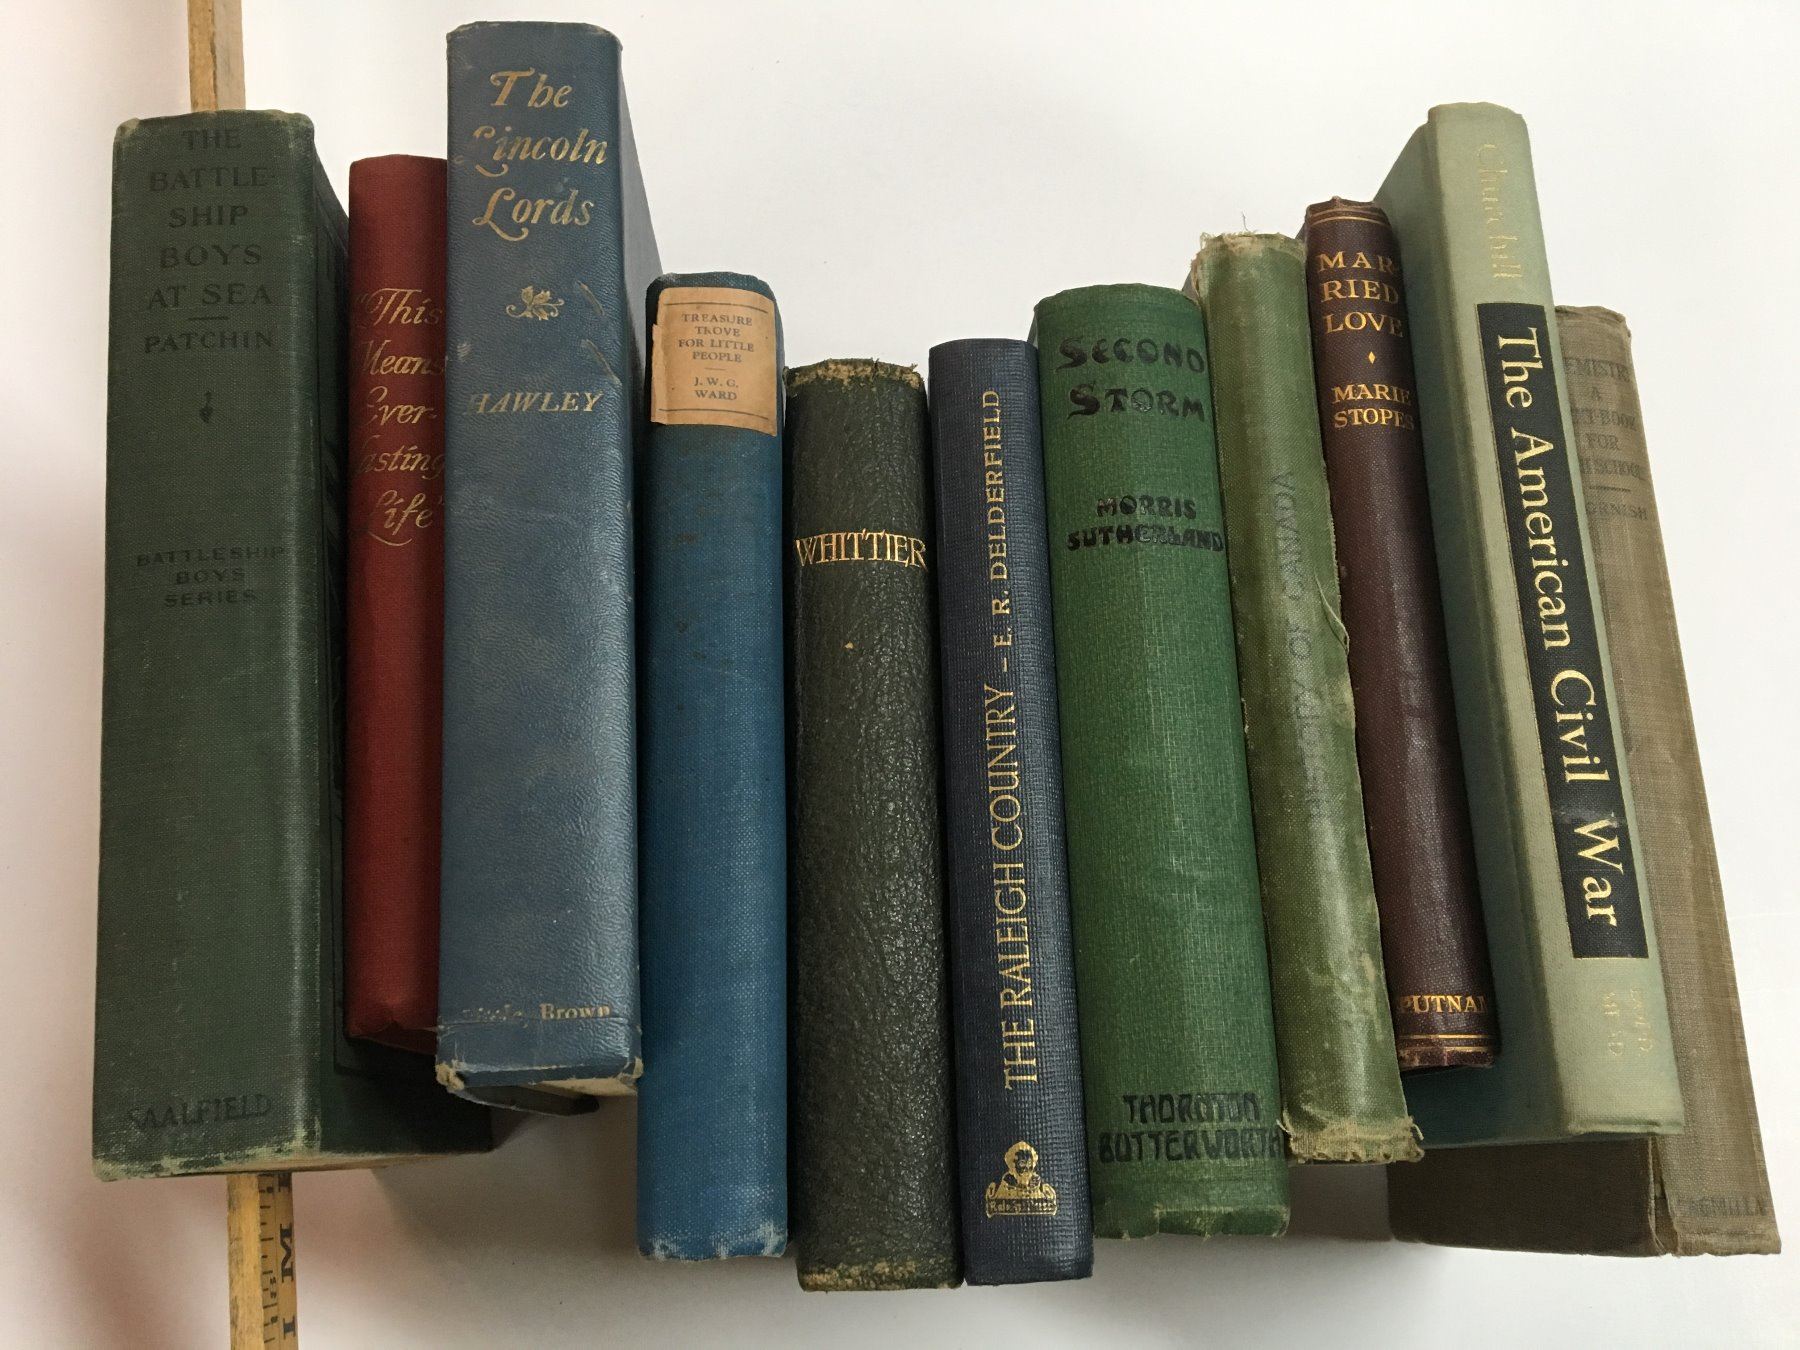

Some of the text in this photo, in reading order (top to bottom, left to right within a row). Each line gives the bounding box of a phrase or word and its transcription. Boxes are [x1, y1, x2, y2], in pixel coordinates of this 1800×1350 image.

[490, 67, 573, 108] The
[182, 129, 242, 150] THE
[472, 125, 608, 178] Lincoln
[168, 205, 249, 229] SHIP
[472, 187, 594, 242] Lords
[160, 244, 263, 269] BOYS
[147, 283, 273, 309] AT SEA
[1321, 279, 1400, 305] RIED
[681, 313, 753, 326] TREASURE
[695, 326, 741, 337] TROVE
[1323, 311, 1404, 338] LOVE
[144, 331, 273, 354] PATCHIN
[678, 338, 755, 352] FOR LITTLE
[1055, 336, 1206, 374] SECOND
[692, 351, 743, 363] PEOPLE
[463, 391, 605, 416] HAWLEY
[694, 390, 738, 401] WARD
[1067, 380, 1206, 422] STORM
[982, 390, 1009, 581] DELDERFIELD
[1097, 495, 1198, 520] MORRIS
[794, 528, 929, 572] WHITTIER
[1067, 524, 1225, 552] SUTHERLAND
[136, 546, 286, 566] BATTLESHIP
[176, 567, 246, 585] BOYS
[164, 589, 258, 608] SERIES
[1497, 327, 1624, 927] The American Civil War
[984, 683, 1023, 851] COUNTRY
[993, 862, 1033, 1008] RALEIGH
[539, 1003, 612, 1020] Brown
[1000, 1018, 1039, 1090] THE
[1122, 1091, 1261, 1124] THORNTON
[1099, 1127, 1282, 1163] BUTTERWORTH
